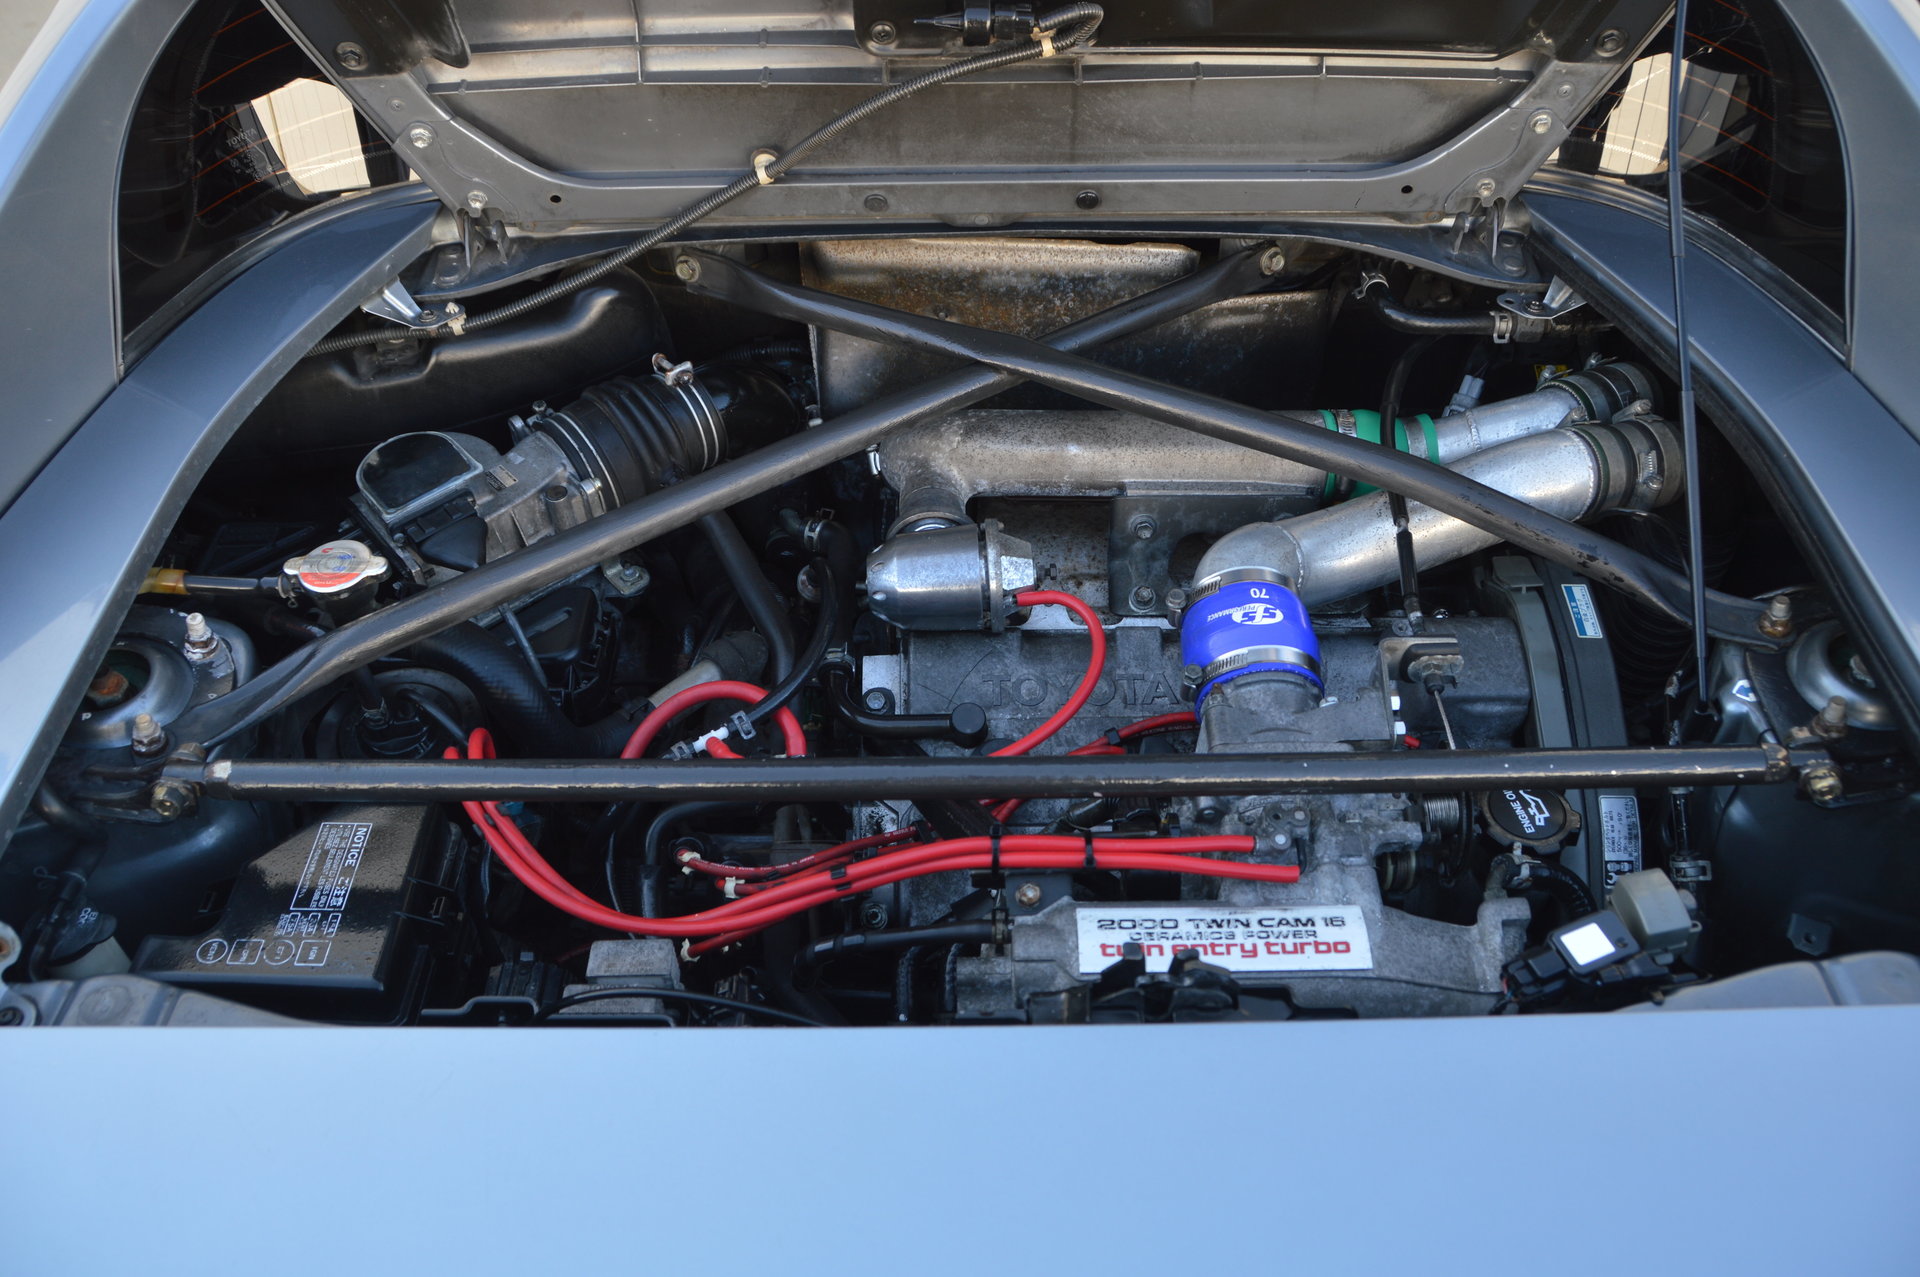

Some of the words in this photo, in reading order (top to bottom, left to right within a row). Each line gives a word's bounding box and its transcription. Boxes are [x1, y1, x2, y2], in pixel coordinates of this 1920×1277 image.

[1250, 588, 1270, 598] 70
[1510, 800, 1535, 833] ENGINE
[344, 827, 367, 867] NOTICE
[1186, 917, 1250, 930] TWIN
[1257, 917, 1315, 928] CAM
[1320, 916, 1346, 927] 16
[1129, 930, 1236, 942] CERAMICS
[1243, 929, 1318, 940] POWER
[308, 945, 319, 960] IGN
[1171, 941, 1259, 958] entry
[1266, 940, 1351, 954] turbo
